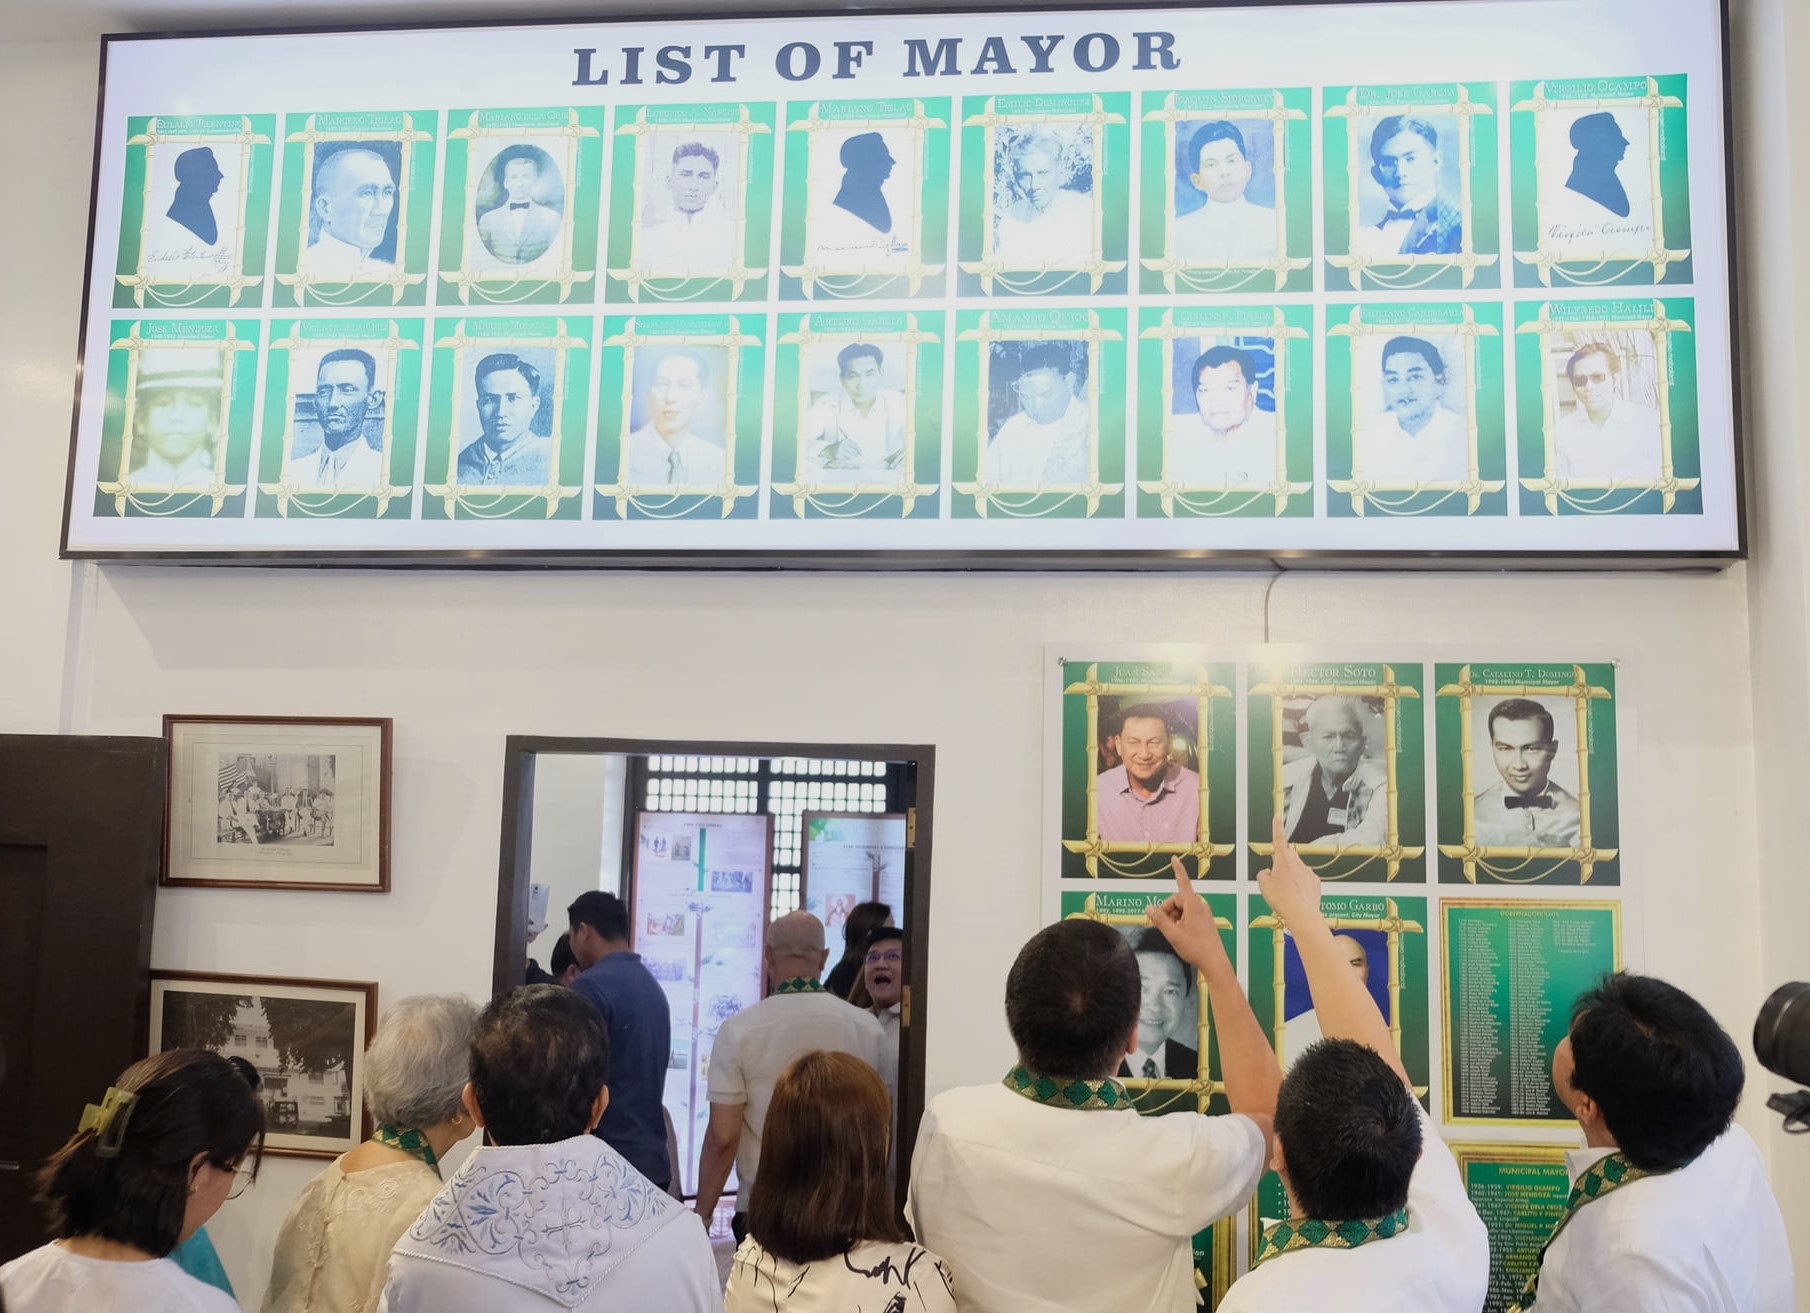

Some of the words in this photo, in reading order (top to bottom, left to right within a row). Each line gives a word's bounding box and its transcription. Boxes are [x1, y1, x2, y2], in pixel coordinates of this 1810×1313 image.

[572, 44, 746, 86] LIST
[775, 40, 874, 82] OF
[903, 31, 1181, 77] MAYOR
[1597, 80, 1647, 91] OCAMPO
[1549, 302, 1608, 314] WILFREDO
[1611, 301, 1654, 313] HALILI
[1343, 664, 1376, 678] SOTO
[1482, 668, 1523, 678] CATALINO
[1525, 669, 1535, 679] T.
[1538, 669, 1577, 679] DOMINGO
[1096, 895, 1142, 907] MARINO
[1348, 899, 1385, 911] GARBO
[1498, 1167, 1541, 1175] MUNICIPAL
